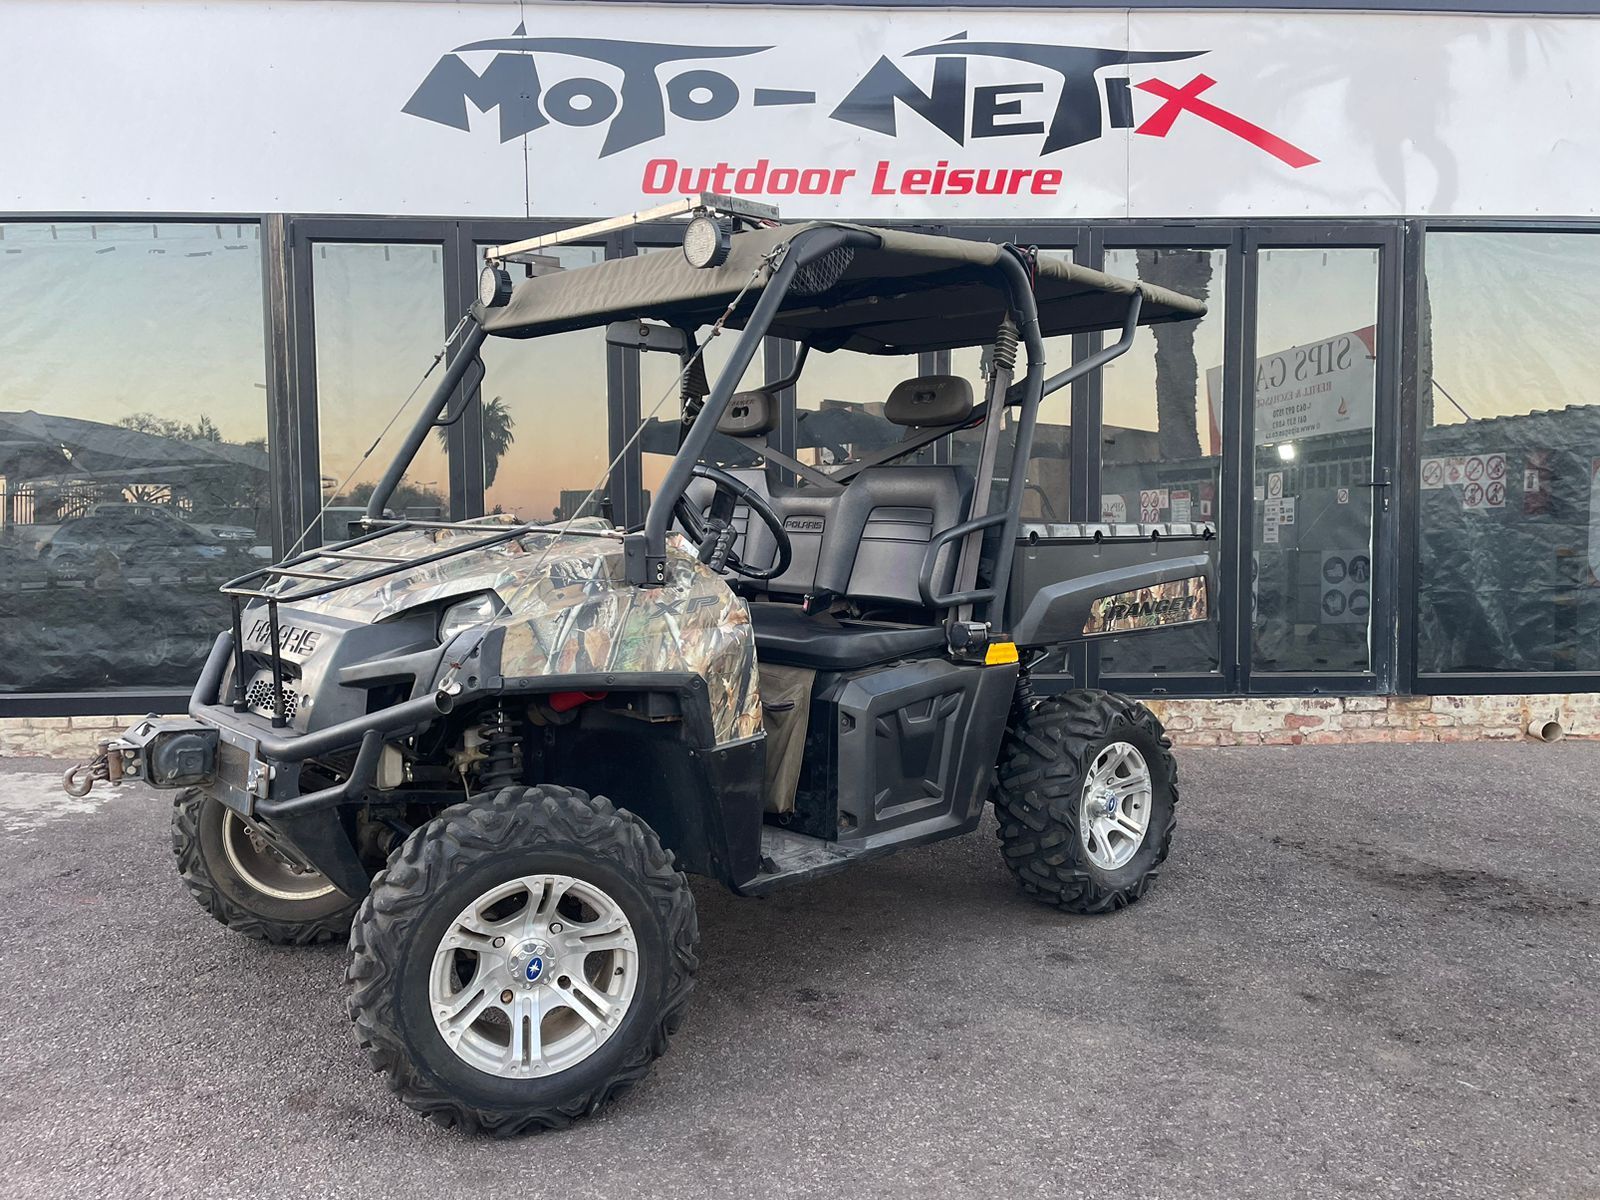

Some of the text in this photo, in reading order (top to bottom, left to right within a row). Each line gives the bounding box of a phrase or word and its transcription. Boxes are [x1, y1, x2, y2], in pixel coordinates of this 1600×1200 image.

[641, 158, 1063, 195] Outdoor Leisure
[785, 521, 823, 529] POLARIS
[648, 595, 720, 620] XP
[1107, 596, 1195, 621] RANGER
